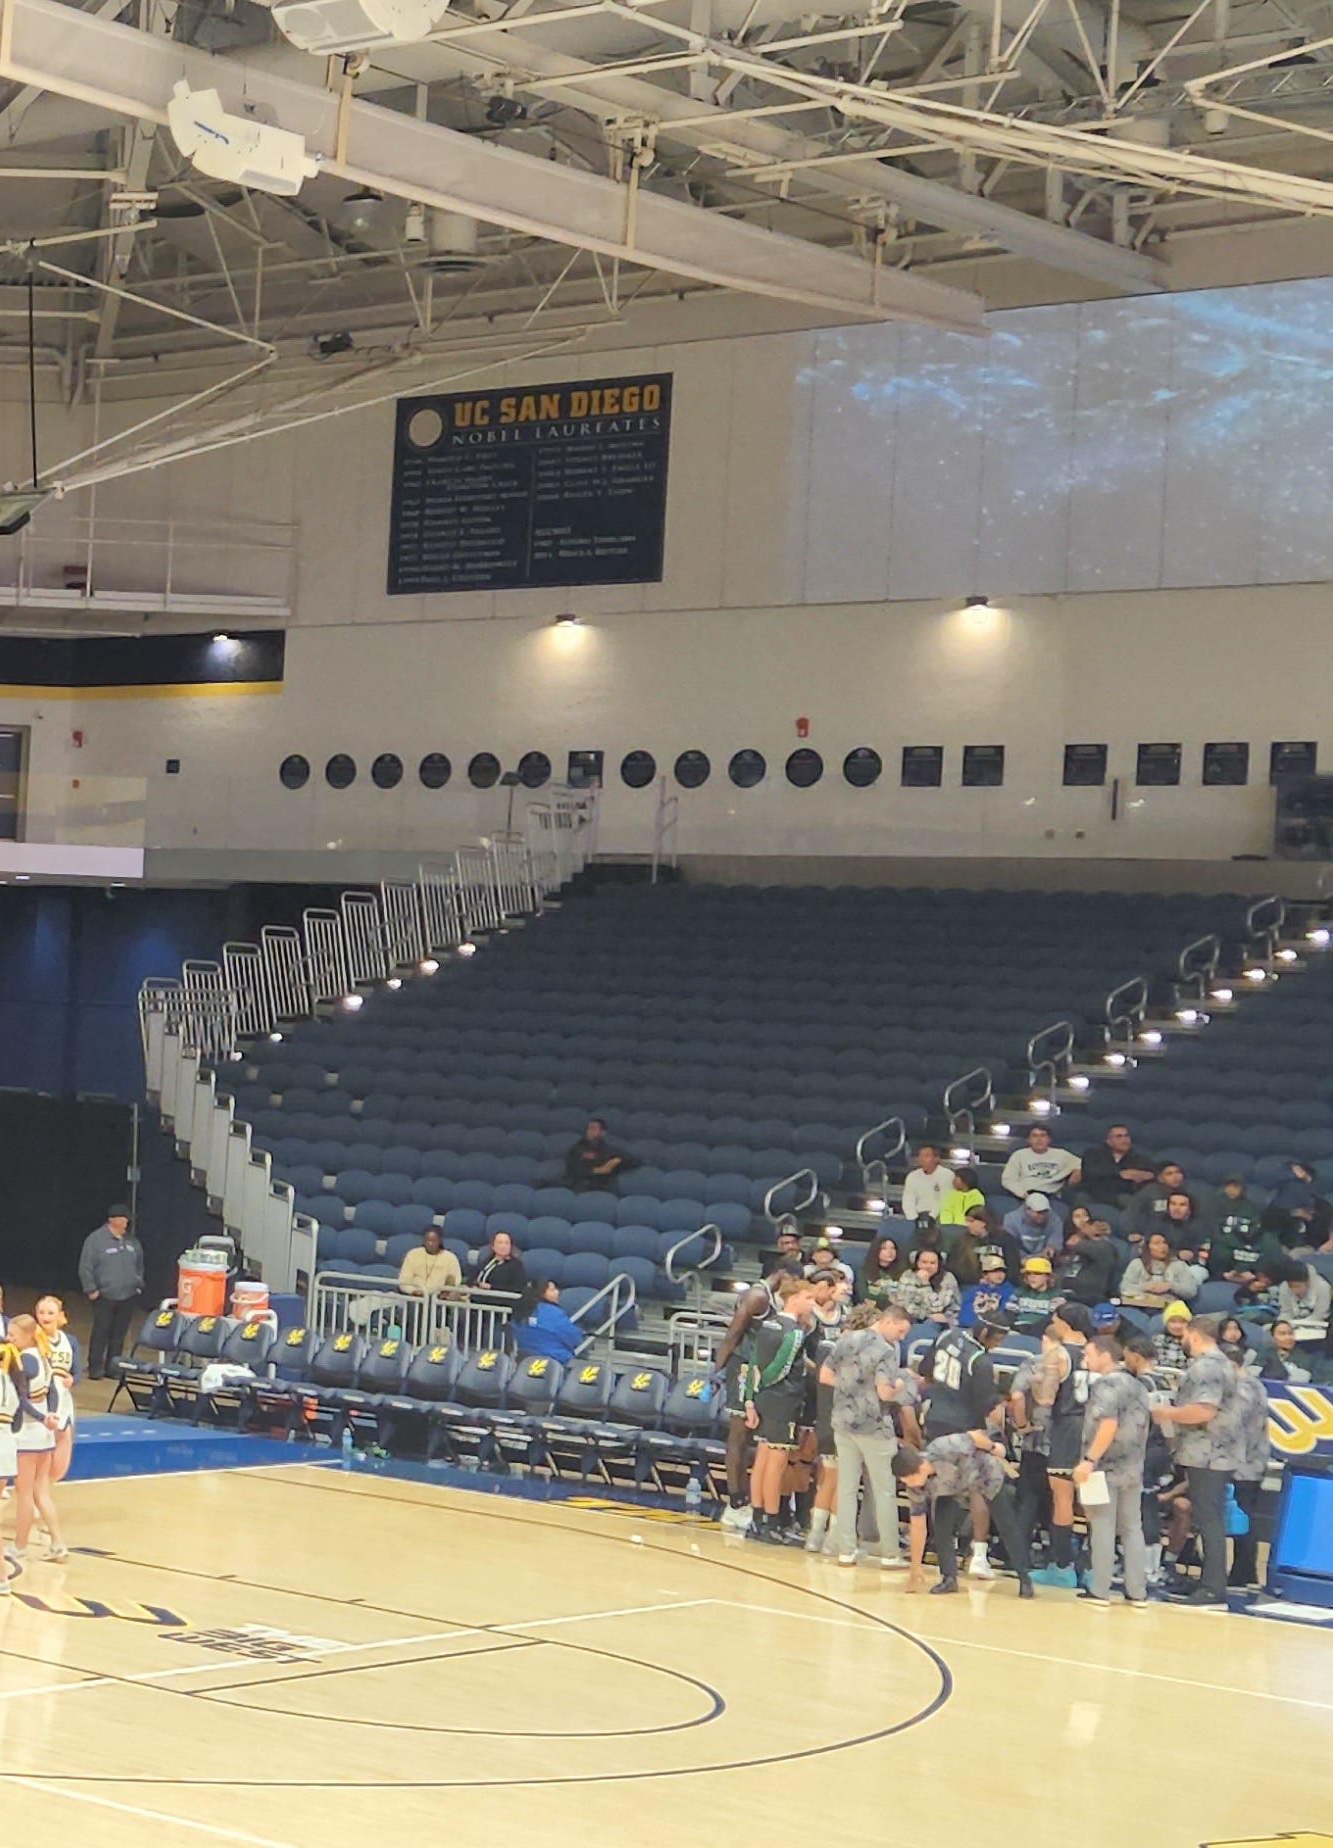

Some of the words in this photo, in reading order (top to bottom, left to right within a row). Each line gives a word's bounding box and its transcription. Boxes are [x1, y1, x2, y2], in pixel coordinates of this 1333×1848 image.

[454, 399, 490, 428] UC
[499, 393, 561, 424] SAN
[569, 384, 661, 419] DIEGO
[452, 430, 522, 446] NOBEL
[535, 417, 661, 440] LAUREATES
[932, 1348, 961, 1390] 20
[156, 1631, 324, 1665] WEST
